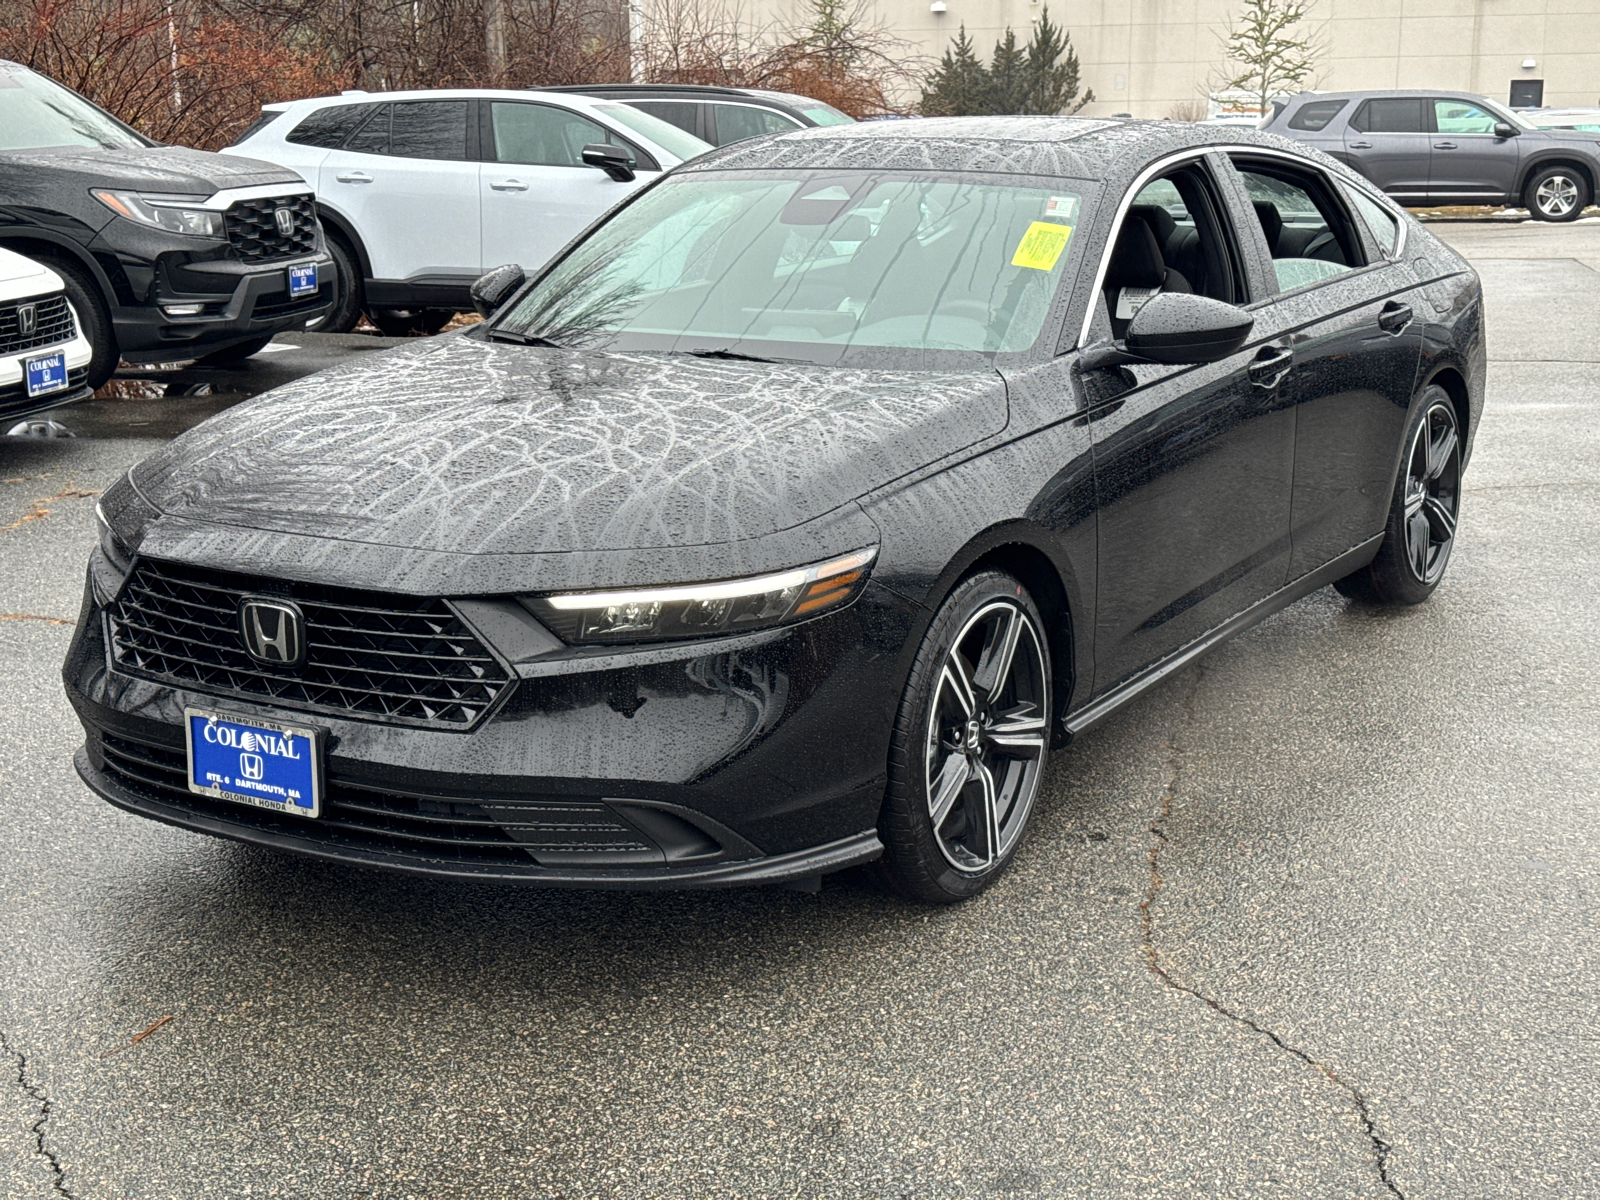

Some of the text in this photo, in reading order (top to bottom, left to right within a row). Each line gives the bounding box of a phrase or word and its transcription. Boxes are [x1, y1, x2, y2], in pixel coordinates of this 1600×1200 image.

[203, 724, 300, 759] COLONIAL
[206, 772, 301, 799] RTE. 6 DARTMOUTH, MA
[220, 791, 287, 811] COLONIAL HONDA
